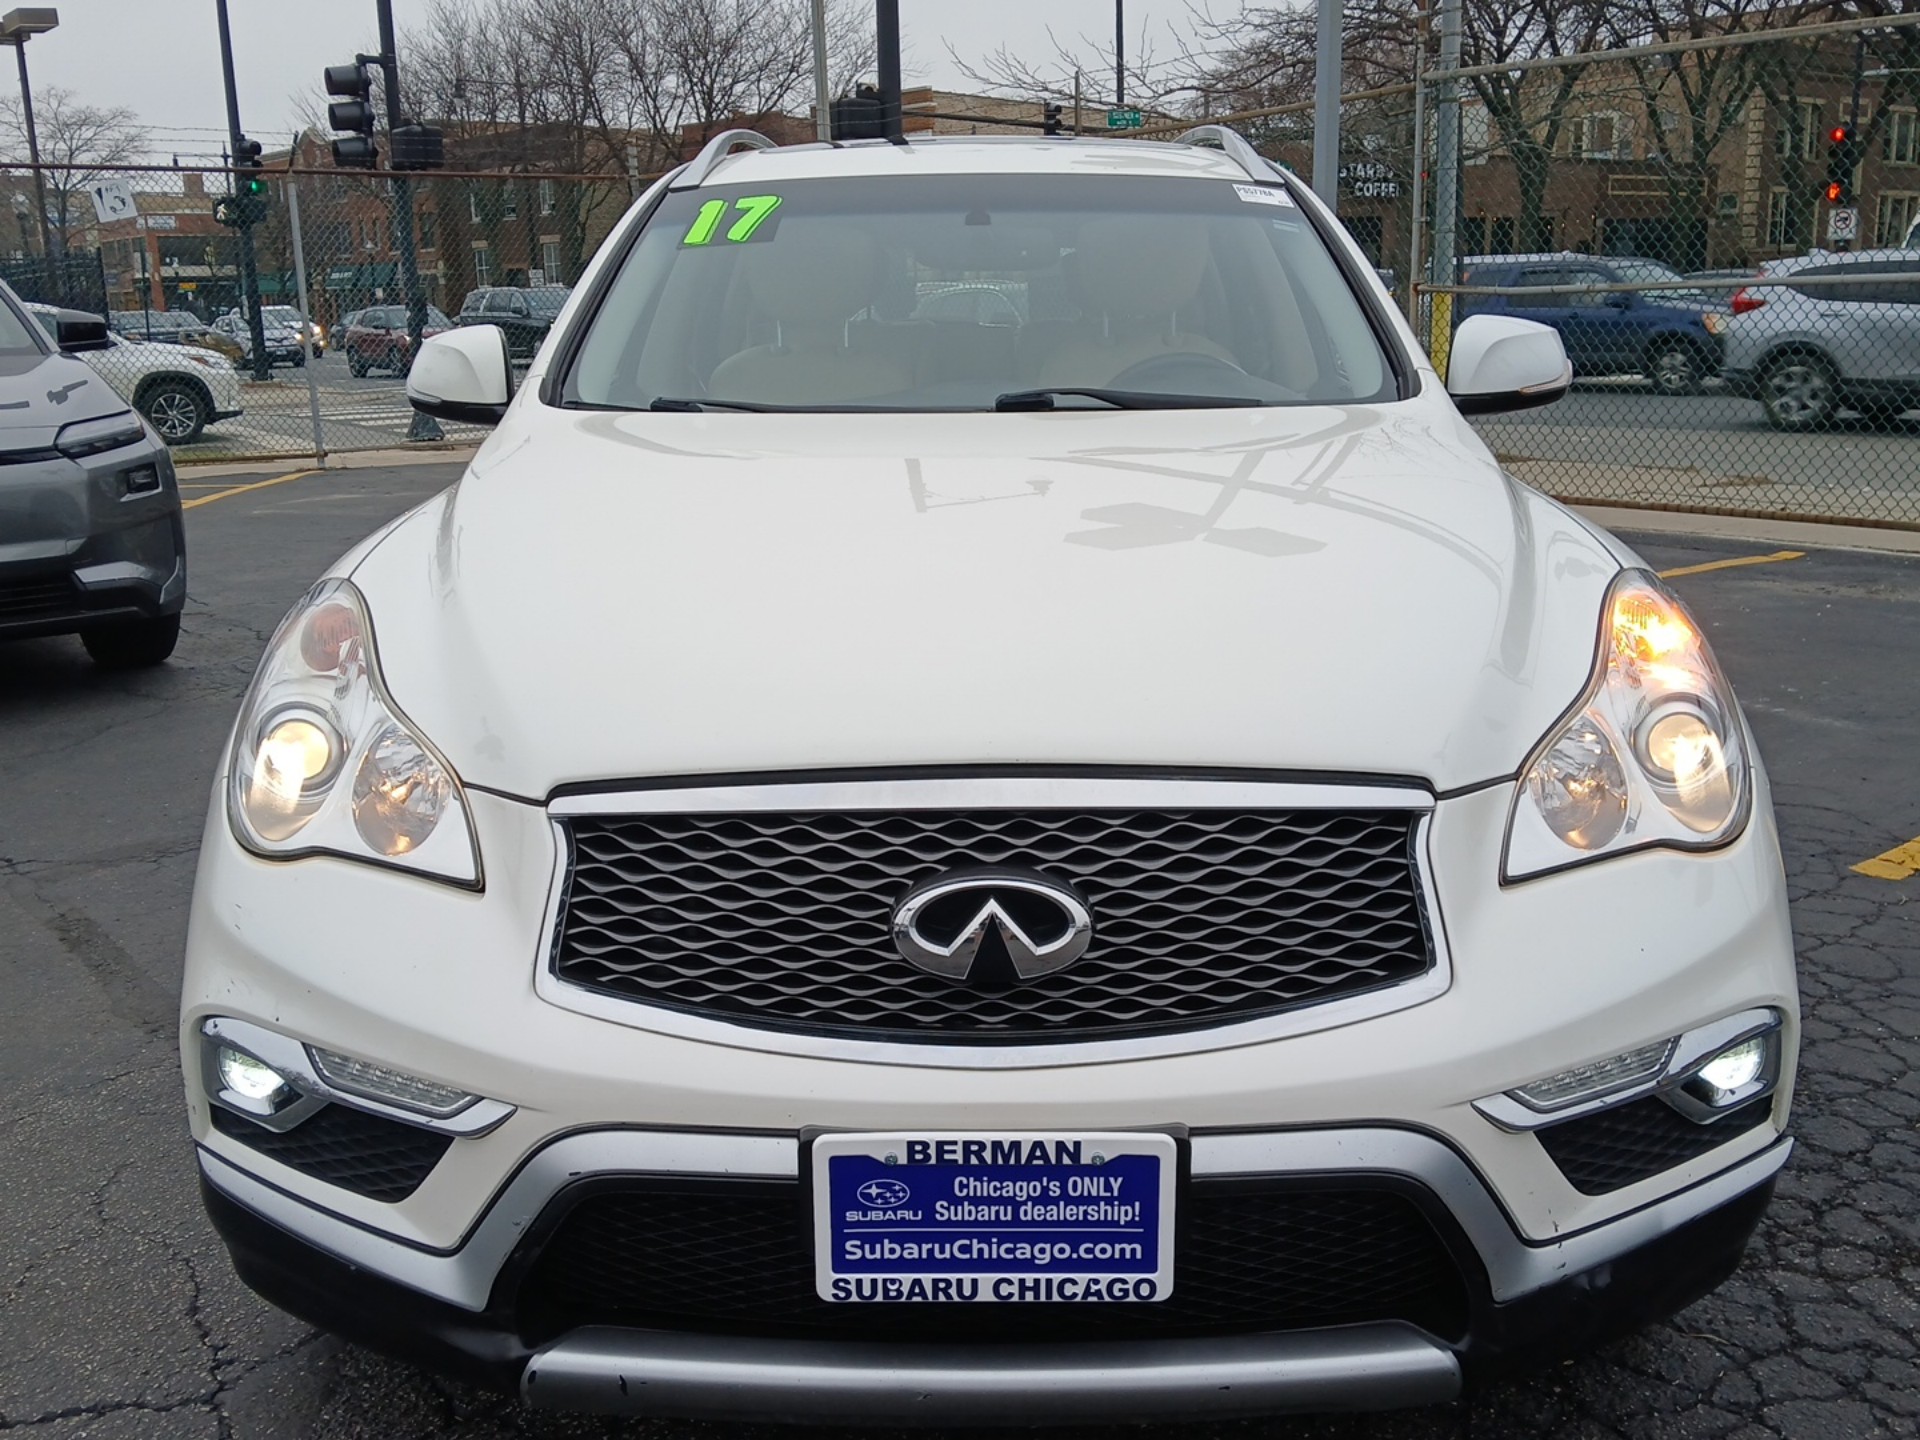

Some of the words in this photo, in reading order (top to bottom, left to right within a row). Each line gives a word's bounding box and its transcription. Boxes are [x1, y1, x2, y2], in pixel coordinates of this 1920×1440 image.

[682, 194, 784, 245] 17
[906, 1140, 1081, 1165] BERMAN
[953, 1176, 1061, 1200] Chicago's
[1067, 1177, 1123, 1197] ONLY
[845, 1210, 922, 1221] SUBARU
[934, 1201, 1012, 1221] Subaru
[1019, 1200, 1140, 1225] dealership!
[844, 1238, 1142, 1265] SubaruChicago.com
[831, 1278, 979, 1301] SUBARU
[991, 1277, 1157, 1301] CHICAGO
